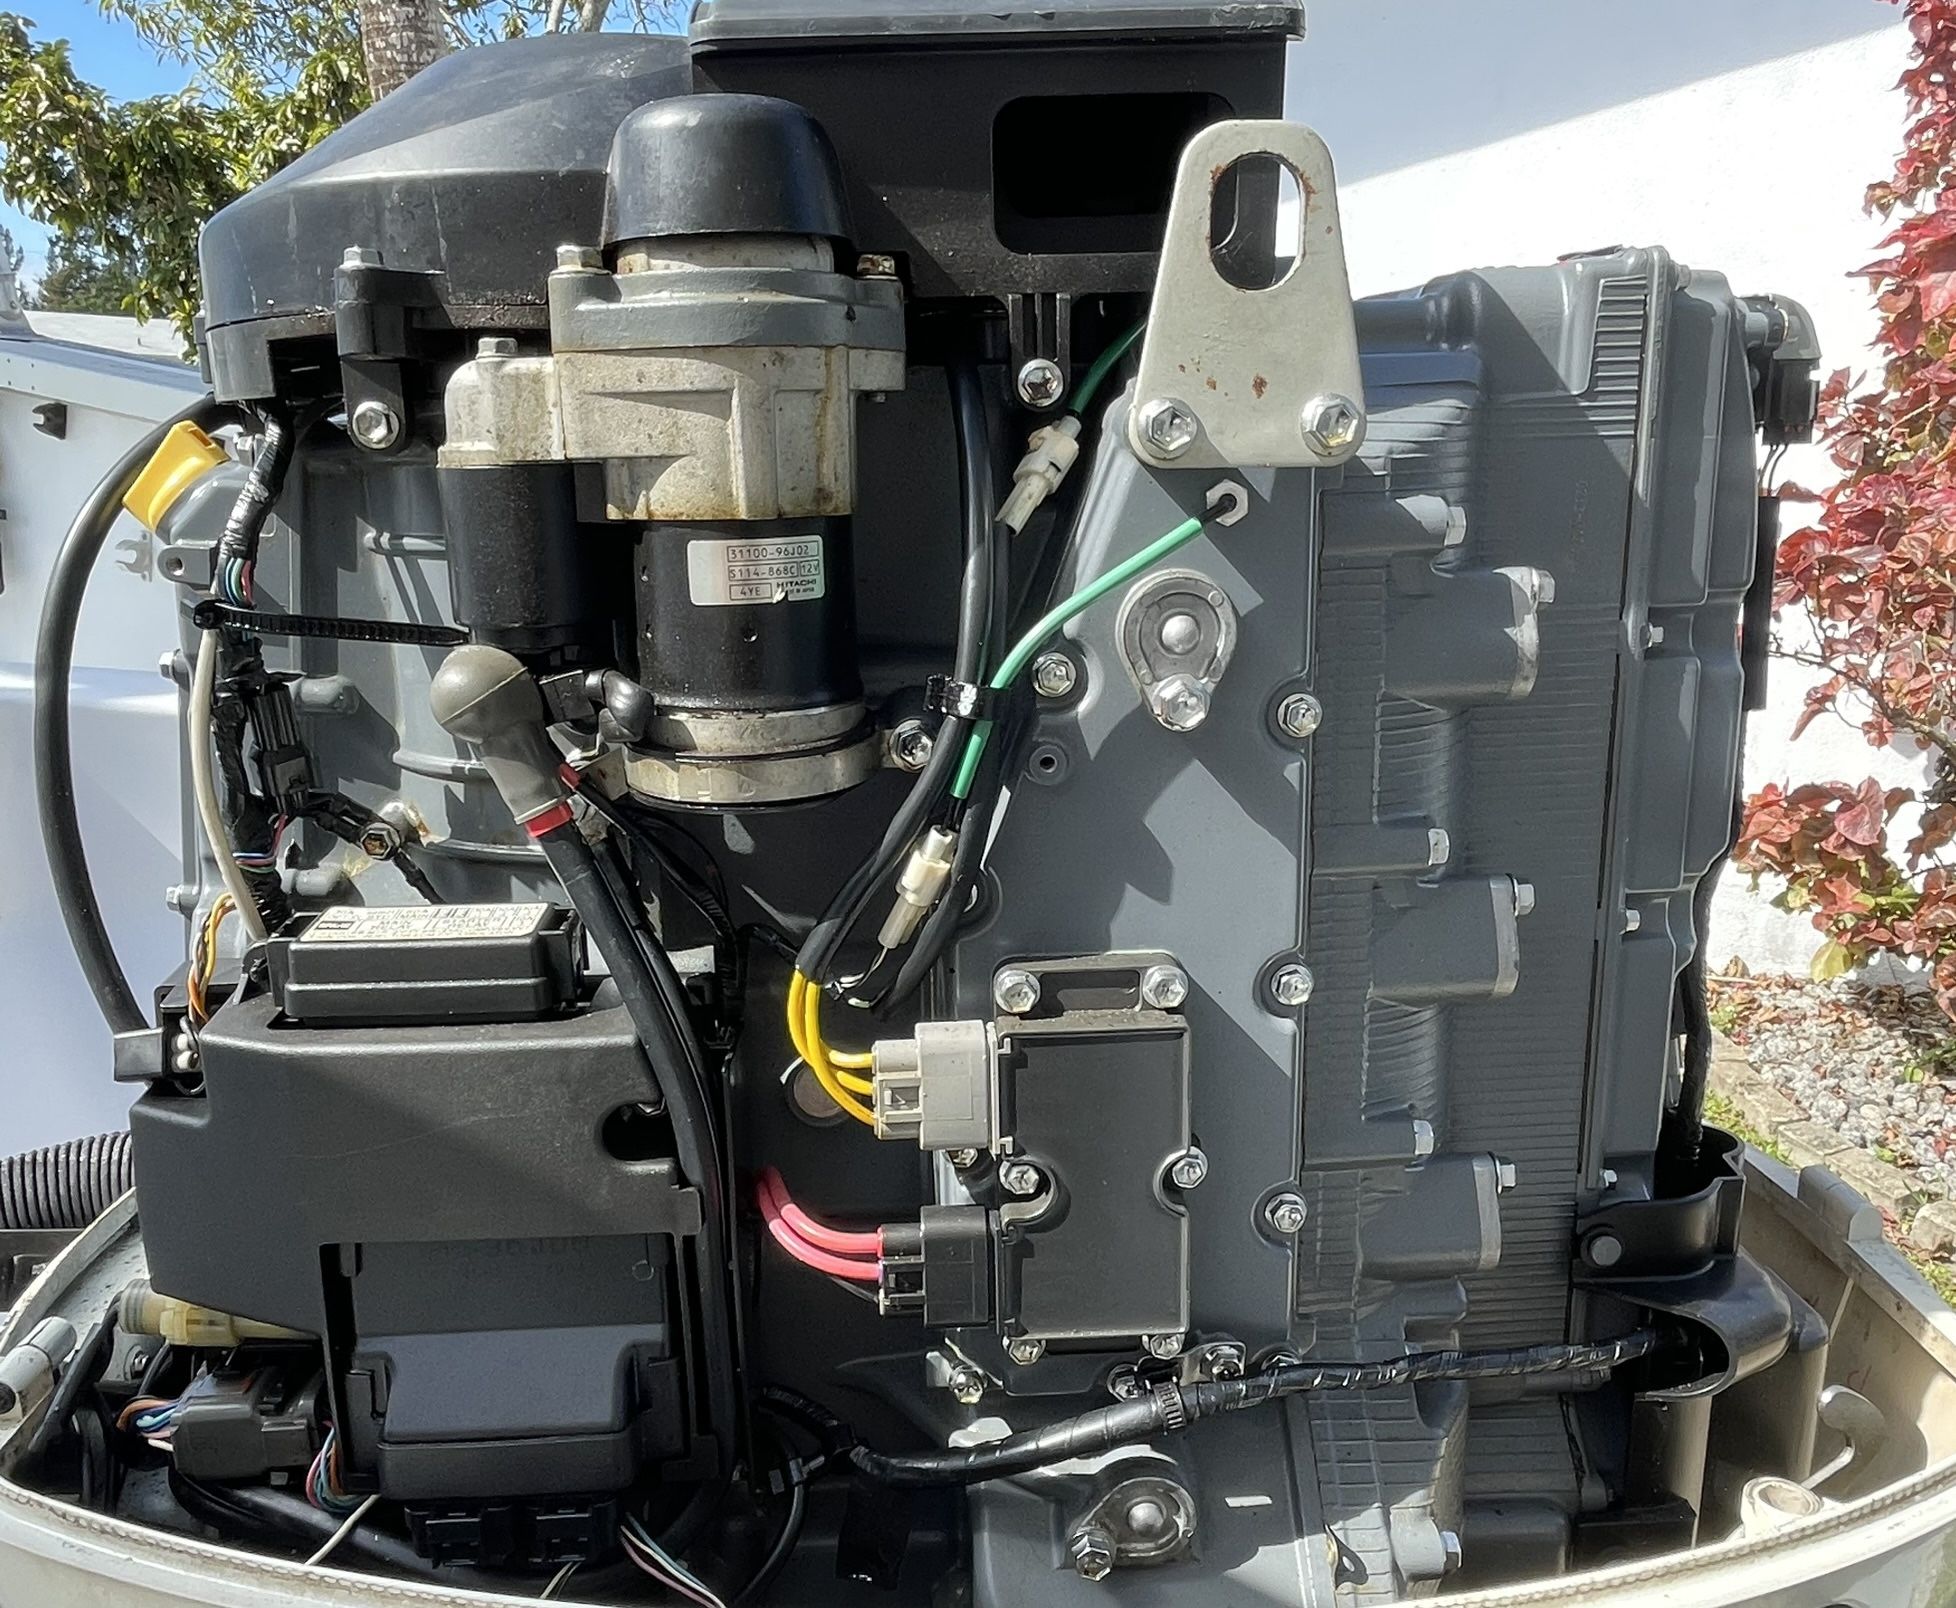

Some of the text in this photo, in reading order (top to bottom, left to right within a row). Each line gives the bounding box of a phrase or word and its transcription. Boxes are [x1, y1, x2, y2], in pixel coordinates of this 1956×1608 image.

[730, 545, 809, 560] 31100-96J02
[729, 565, 796, 579] S114-868C
[801, 562, 819, 575] 12V
[776, 578, 817, 589] HITACHI
[739, 586, 761, 597] 4YE
